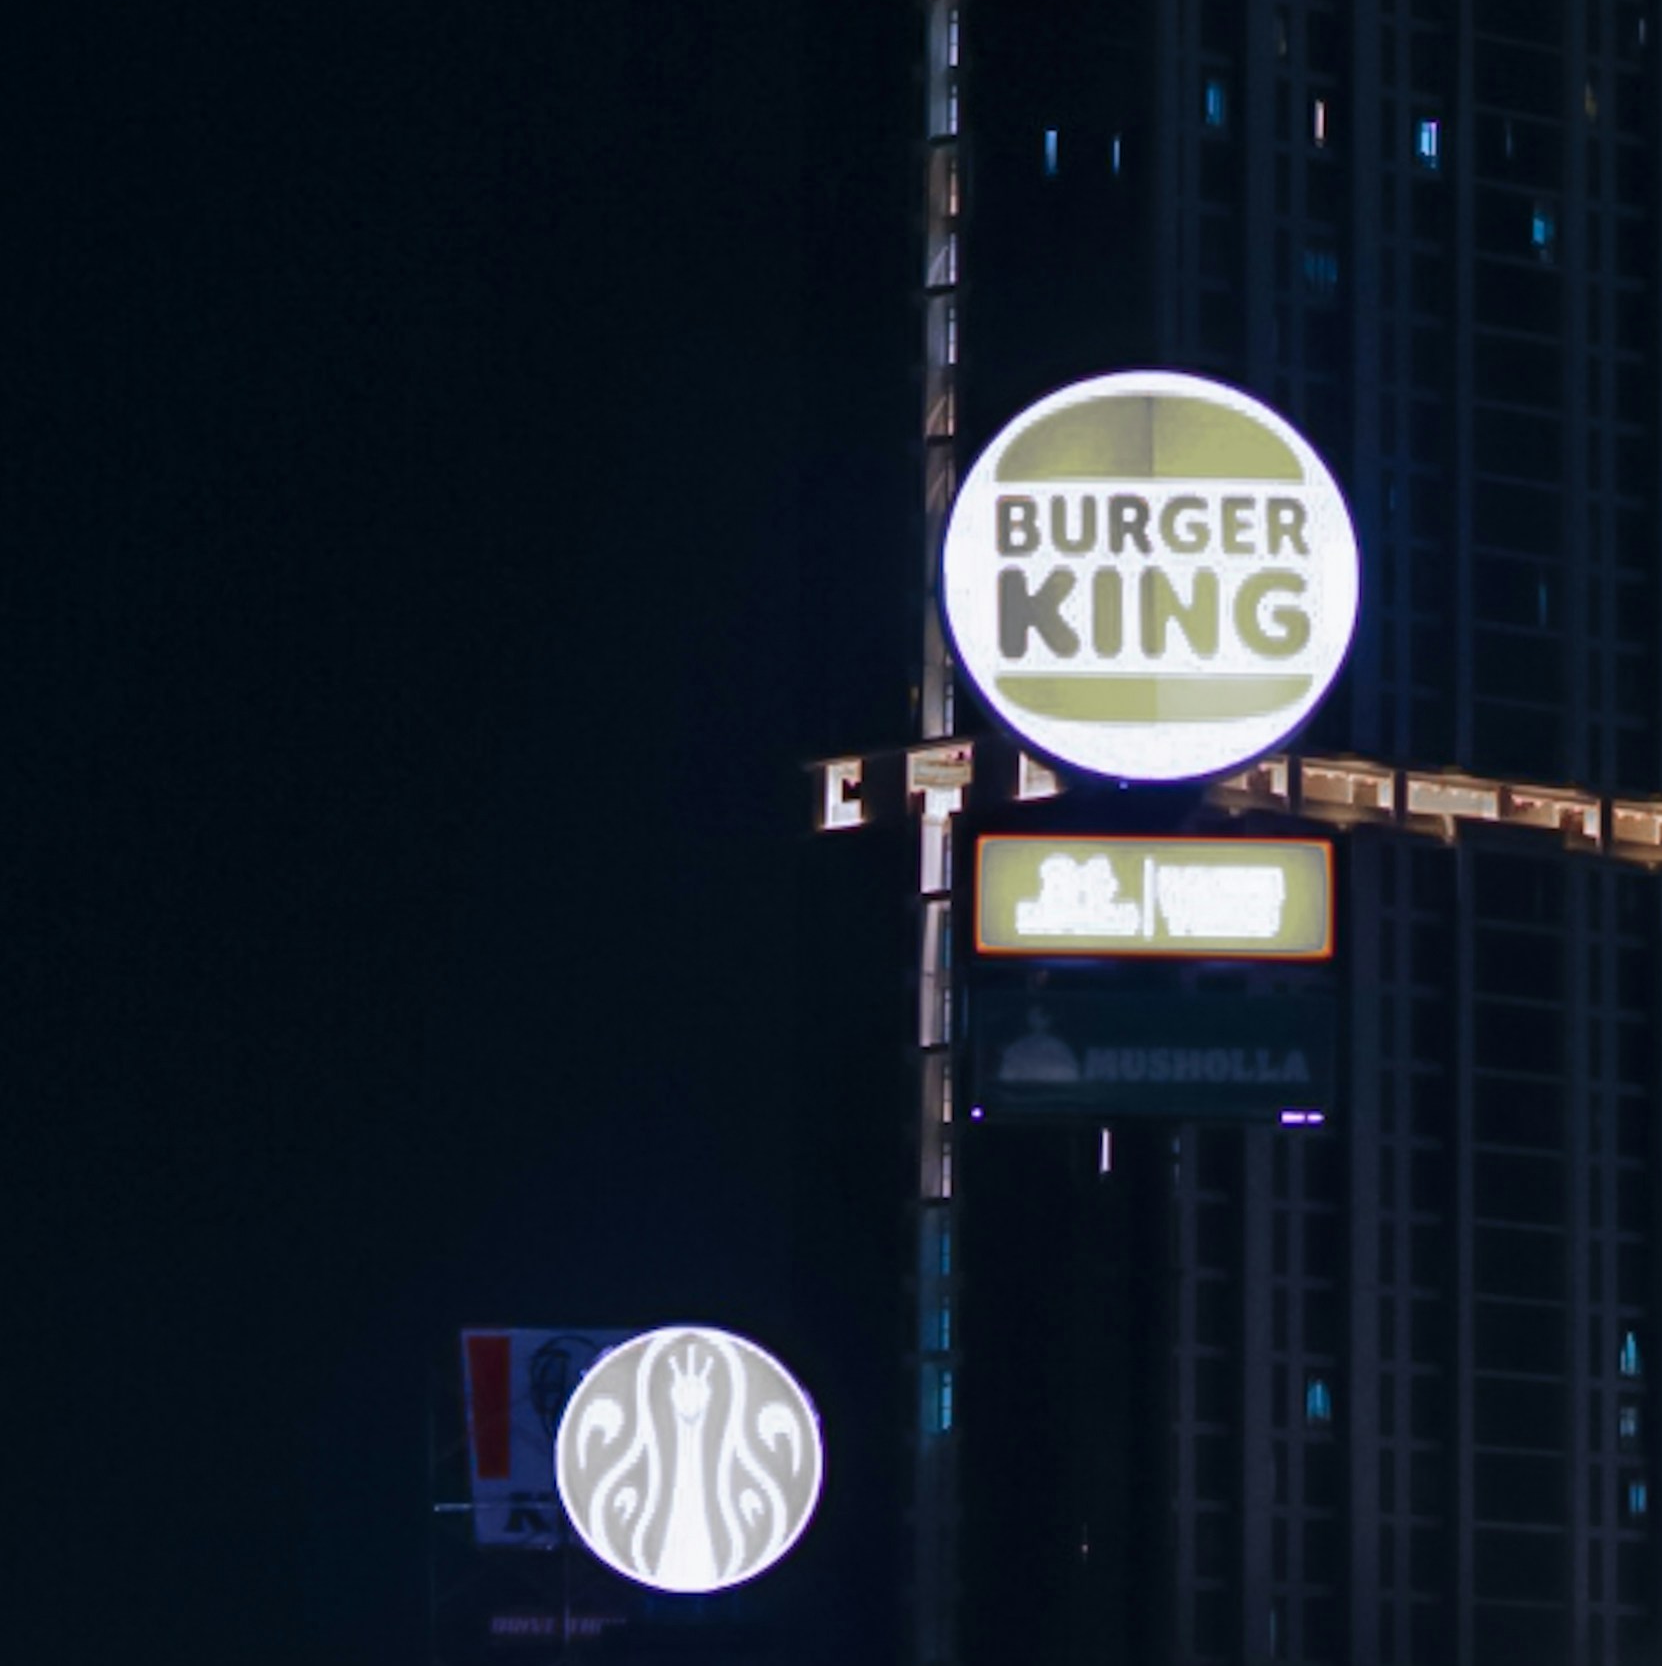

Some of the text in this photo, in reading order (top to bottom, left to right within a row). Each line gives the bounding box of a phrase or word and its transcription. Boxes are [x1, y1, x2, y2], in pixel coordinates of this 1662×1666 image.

[994, 492, 1310, 558] BURGER
[996, 564, 1312, 660] KING
[1084, 1046, 1311, 1084] MUSHOLLA
